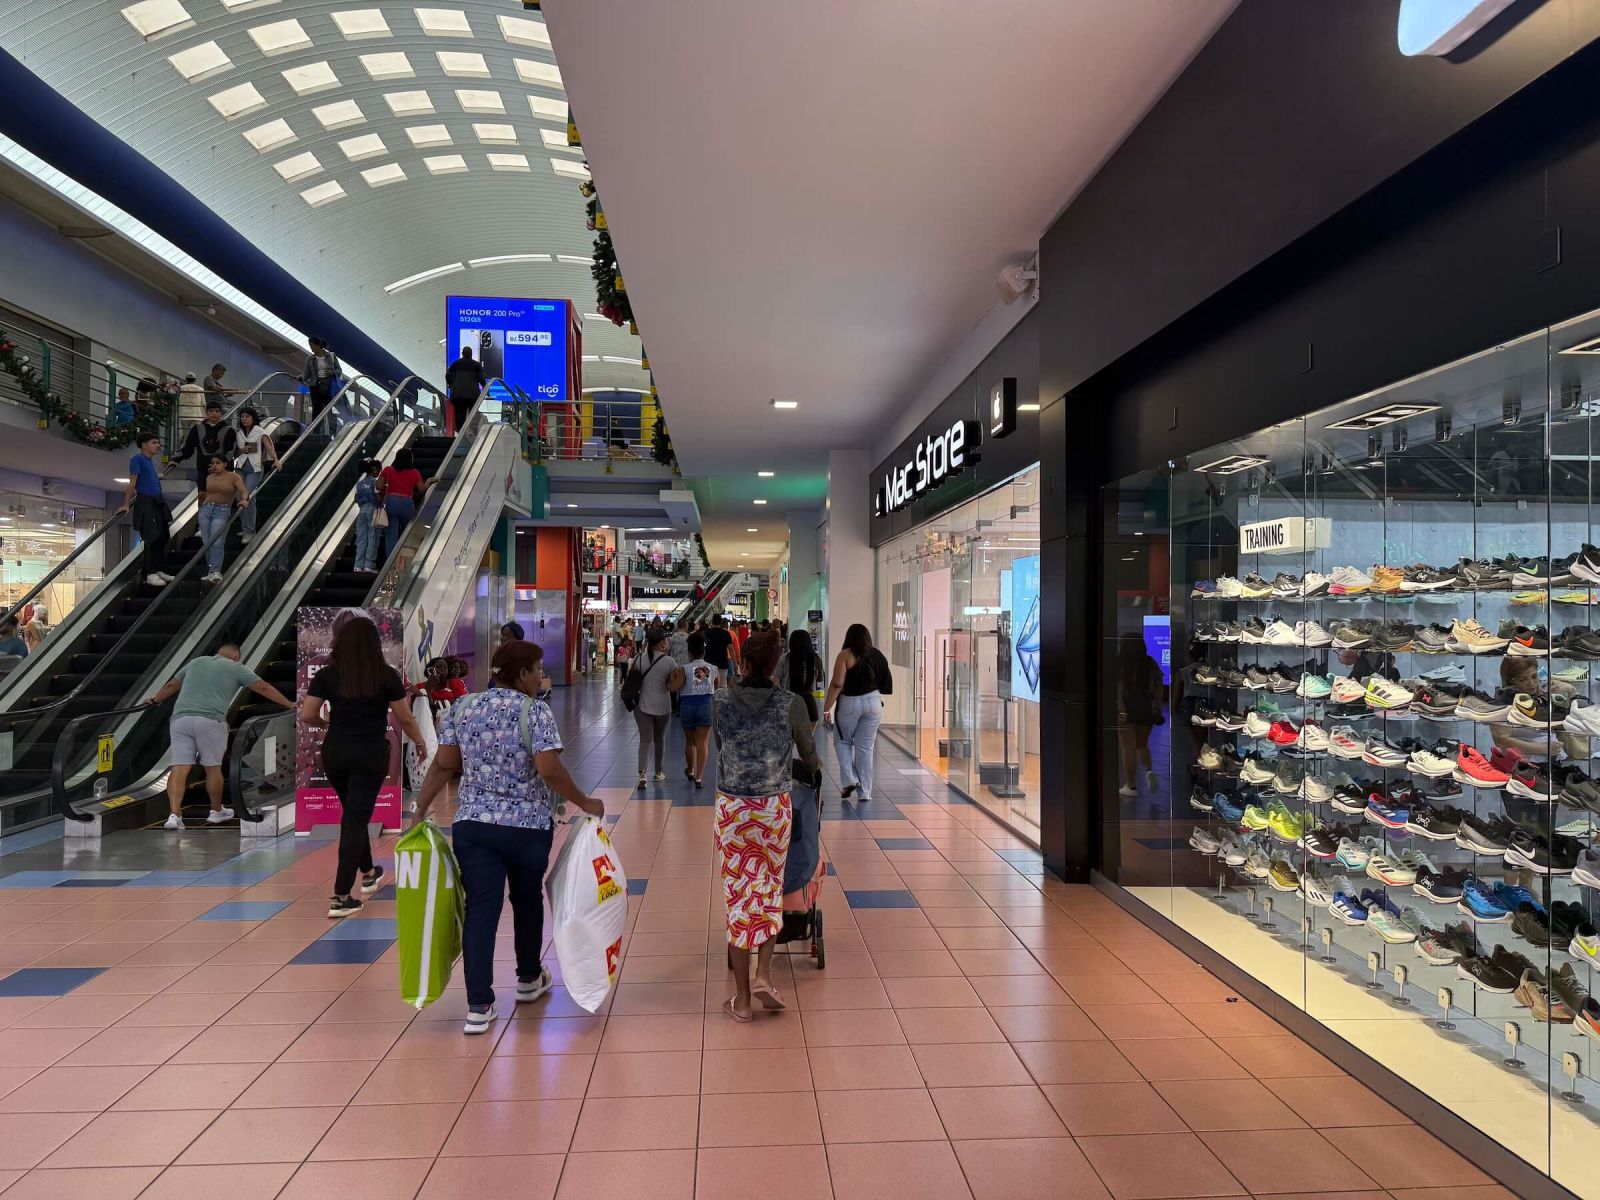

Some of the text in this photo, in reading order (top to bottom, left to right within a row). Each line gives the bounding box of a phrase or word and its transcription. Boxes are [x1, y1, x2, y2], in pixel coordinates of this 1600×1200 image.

[459, 308, 492, 316] HONOR
[885, 419, 965, 514] Mac Store
[1245, 523, 1284, 549] TRAINING
